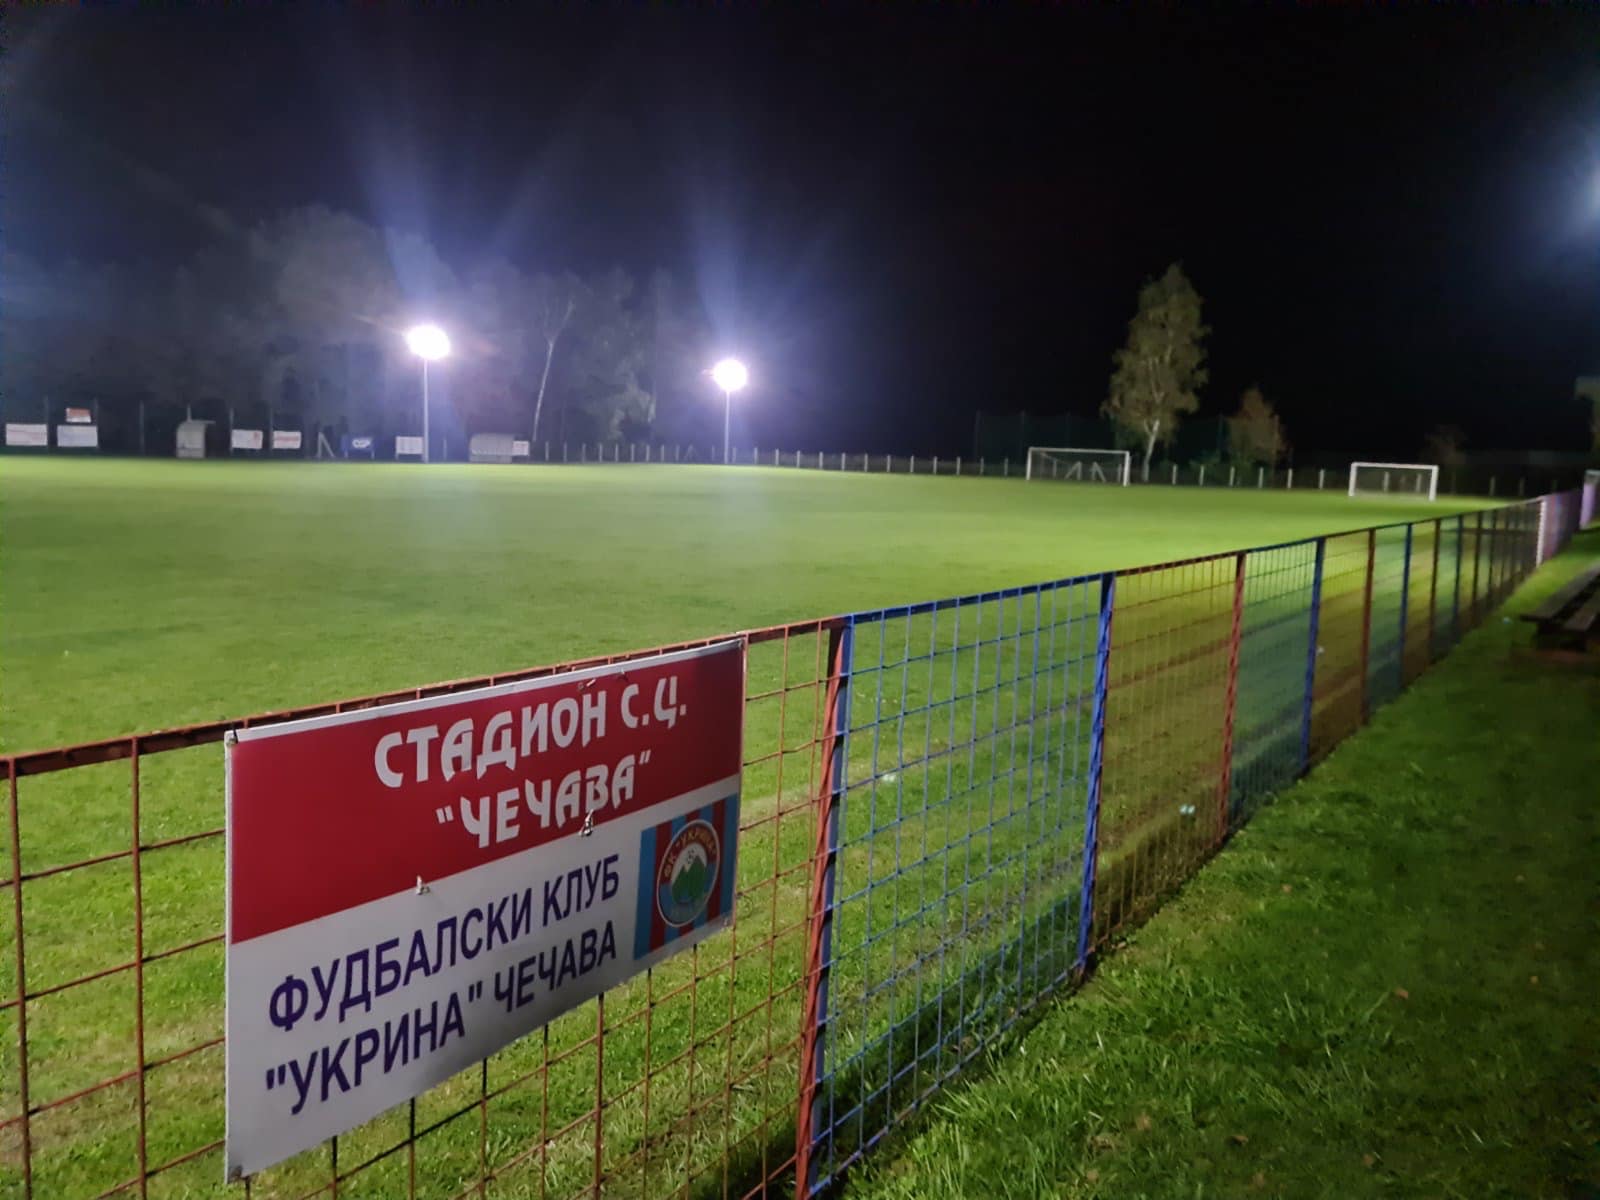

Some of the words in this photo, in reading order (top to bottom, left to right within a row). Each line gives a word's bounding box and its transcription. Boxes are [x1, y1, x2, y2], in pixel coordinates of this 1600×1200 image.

[374, 690, 608, 788] СТАДИОН
[621, 676, 687, 730] С.Ц.
[435, 750, 651, 848] "ЧЕЧАВА"
[269, 888, 532, 1033] ФУДБАЛСКИ
[543, 853, 620, 927] КЛУБ
[265, 980, 482, 1116] "УКРИНА"
[494, 920, 616, 1013] ЧЕЧАВА
